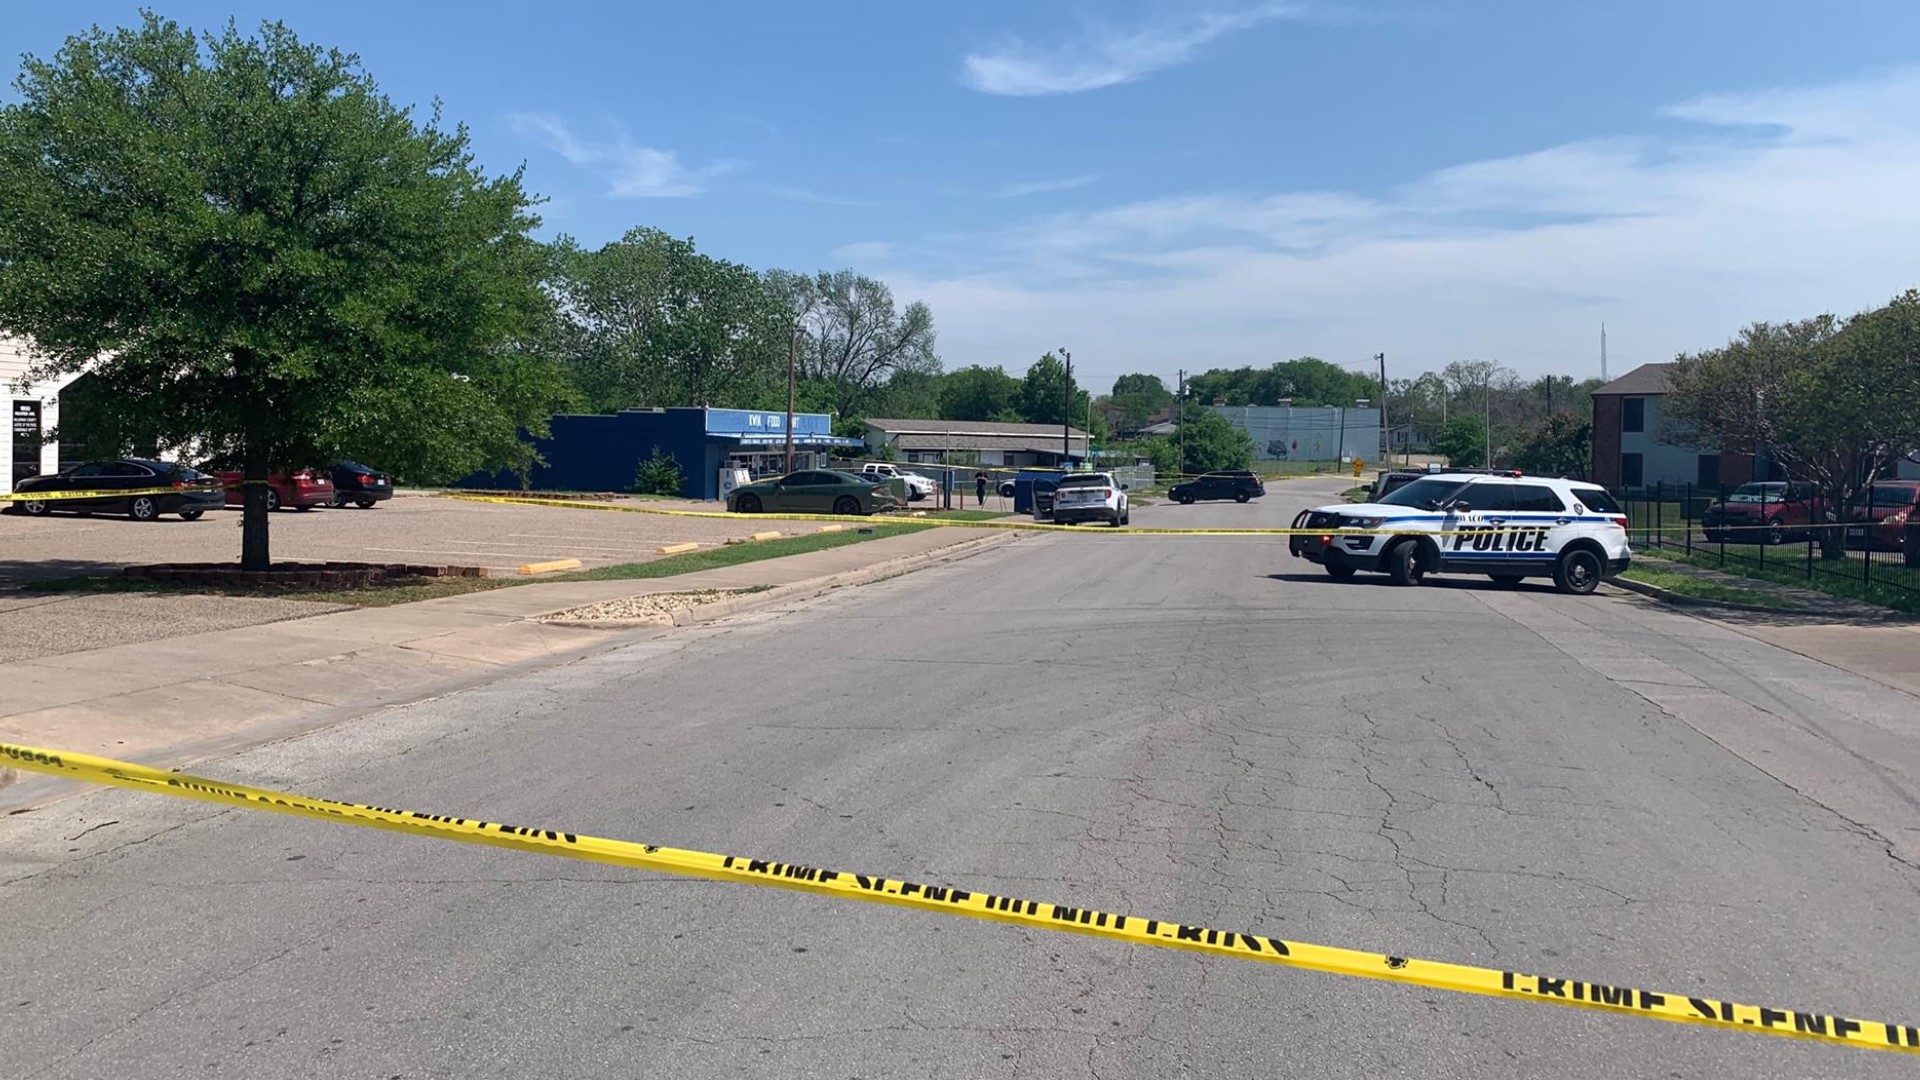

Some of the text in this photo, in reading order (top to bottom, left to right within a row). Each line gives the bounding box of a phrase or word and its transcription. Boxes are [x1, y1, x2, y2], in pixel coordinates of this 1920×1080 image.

[767, 415, 781, 428] FOOD
[1458, 514, 1484, 522] WACO
[1453, 525, 1551, 551] POLICE
